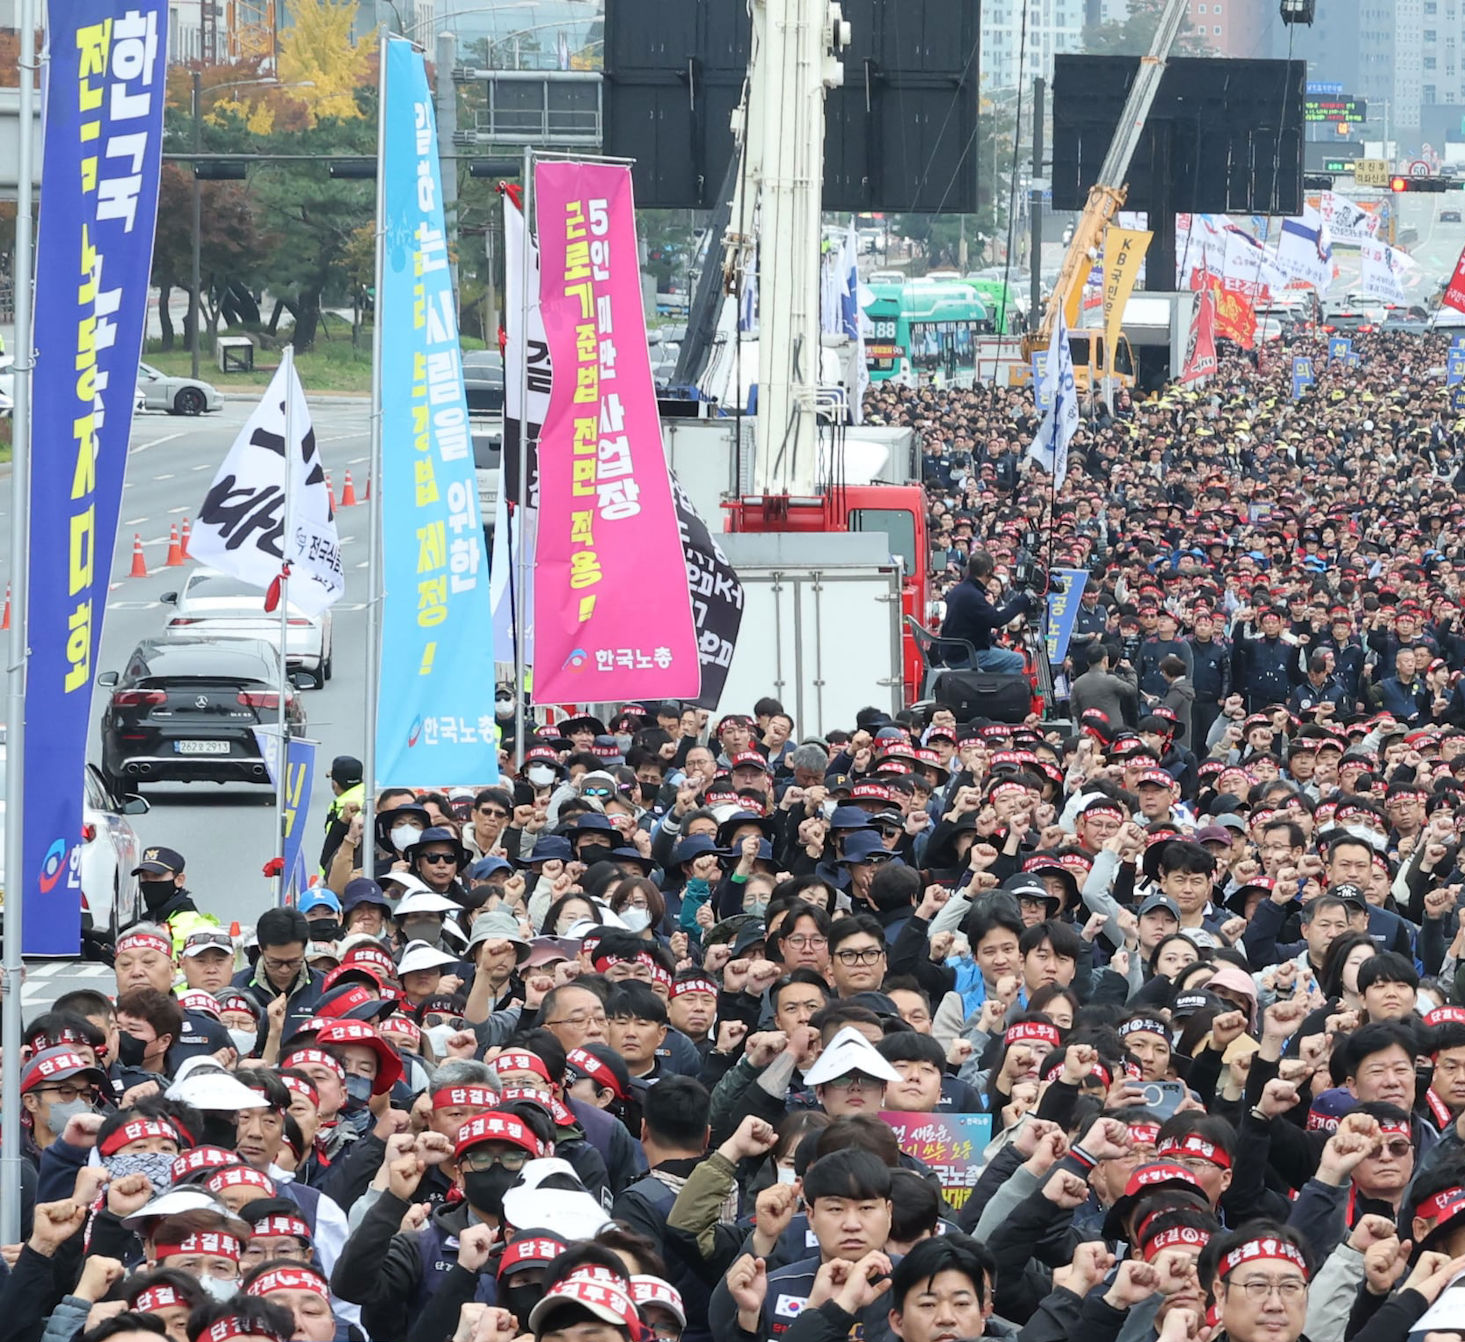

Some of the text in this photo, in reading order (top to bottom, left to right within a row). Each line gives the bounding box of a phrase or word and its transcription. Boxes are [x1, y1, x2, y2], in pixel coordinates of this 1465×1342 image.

[587, 199, 611, 281] 5인
[564, 201, 600, 404] 근로기준법
[572, 416, 598, 497] 전면
[596, 393, 642, 521] 사업장
[445, 478, 482, 593] 위한
[595, 647, 673, 672] 한국노총
